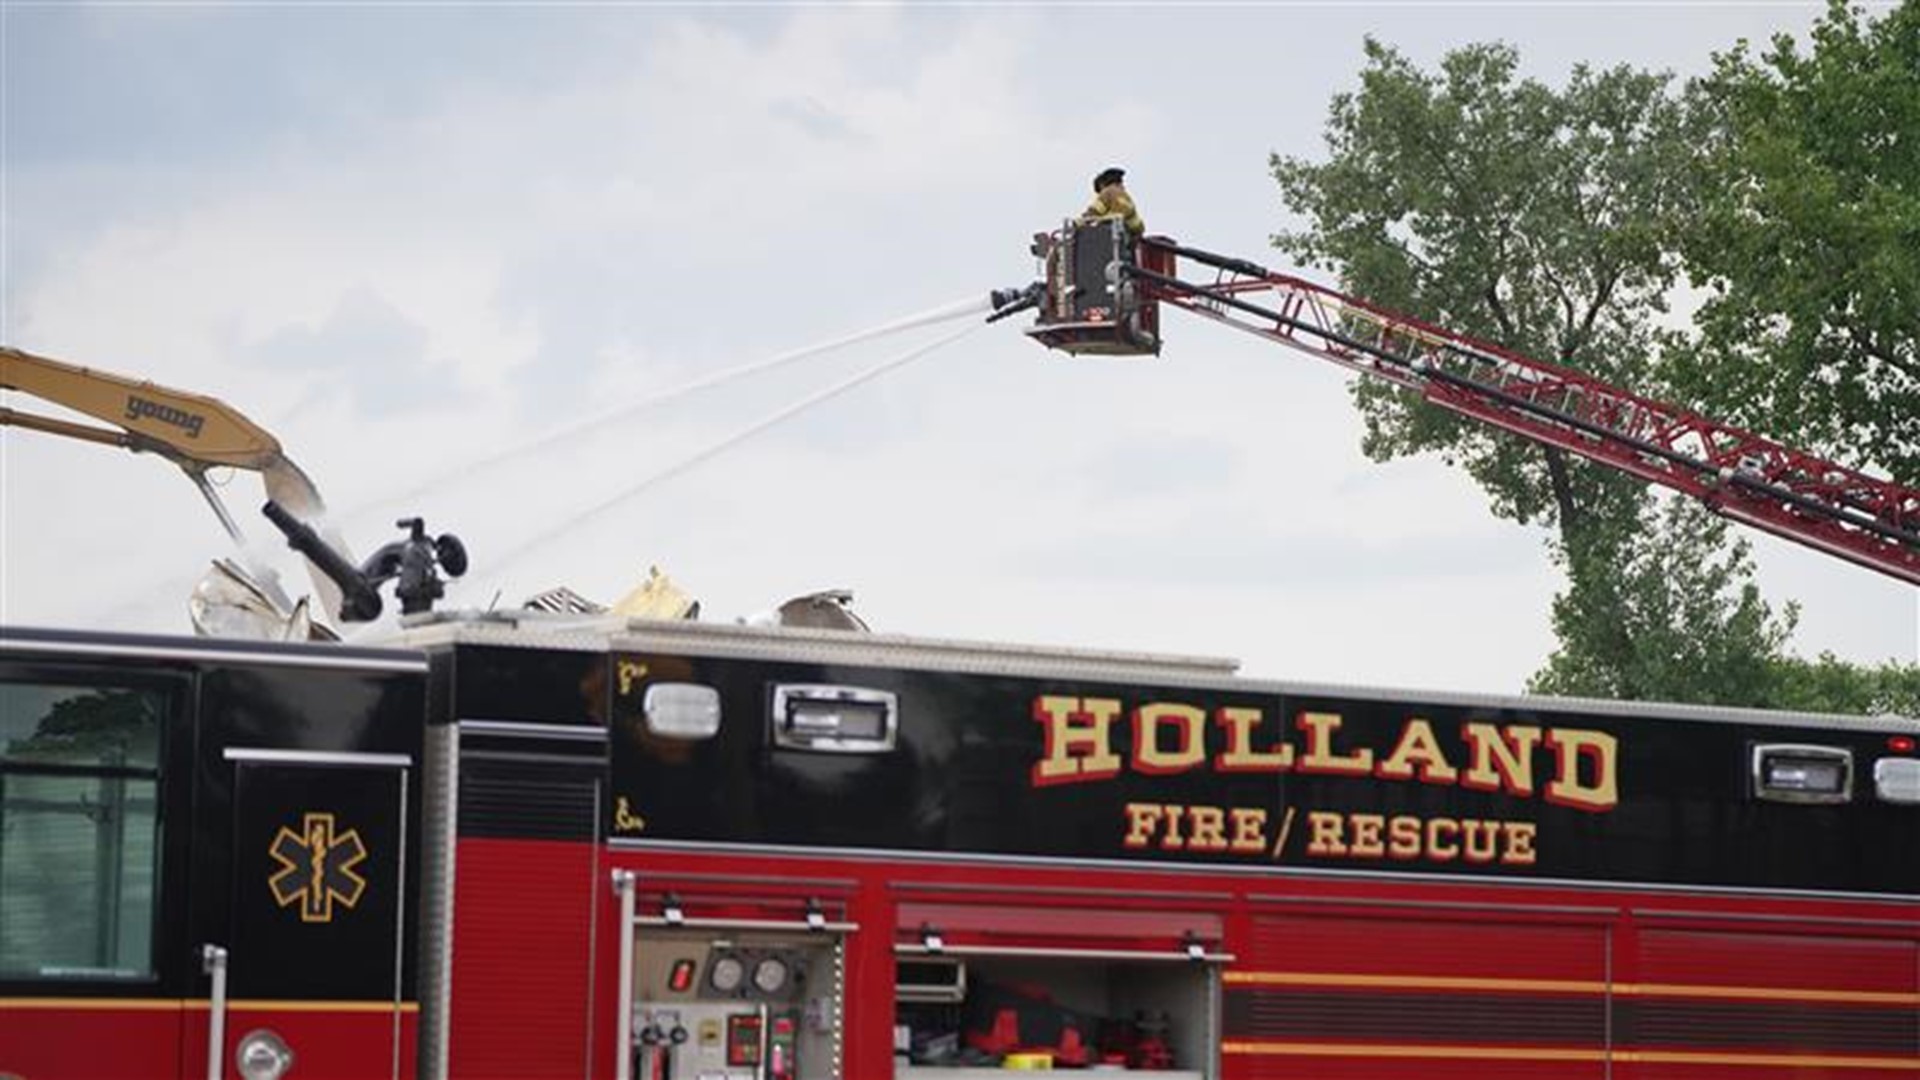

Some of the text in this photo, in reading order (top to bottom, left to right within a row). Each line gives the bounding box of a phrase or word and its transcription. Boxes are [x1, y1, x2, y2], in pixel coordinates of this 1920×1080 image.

[125, 395, 204, 438] young
[1032, 695, 1618, 808] HOLLAND
[1307, 811, 1536, 863] RESCUE
